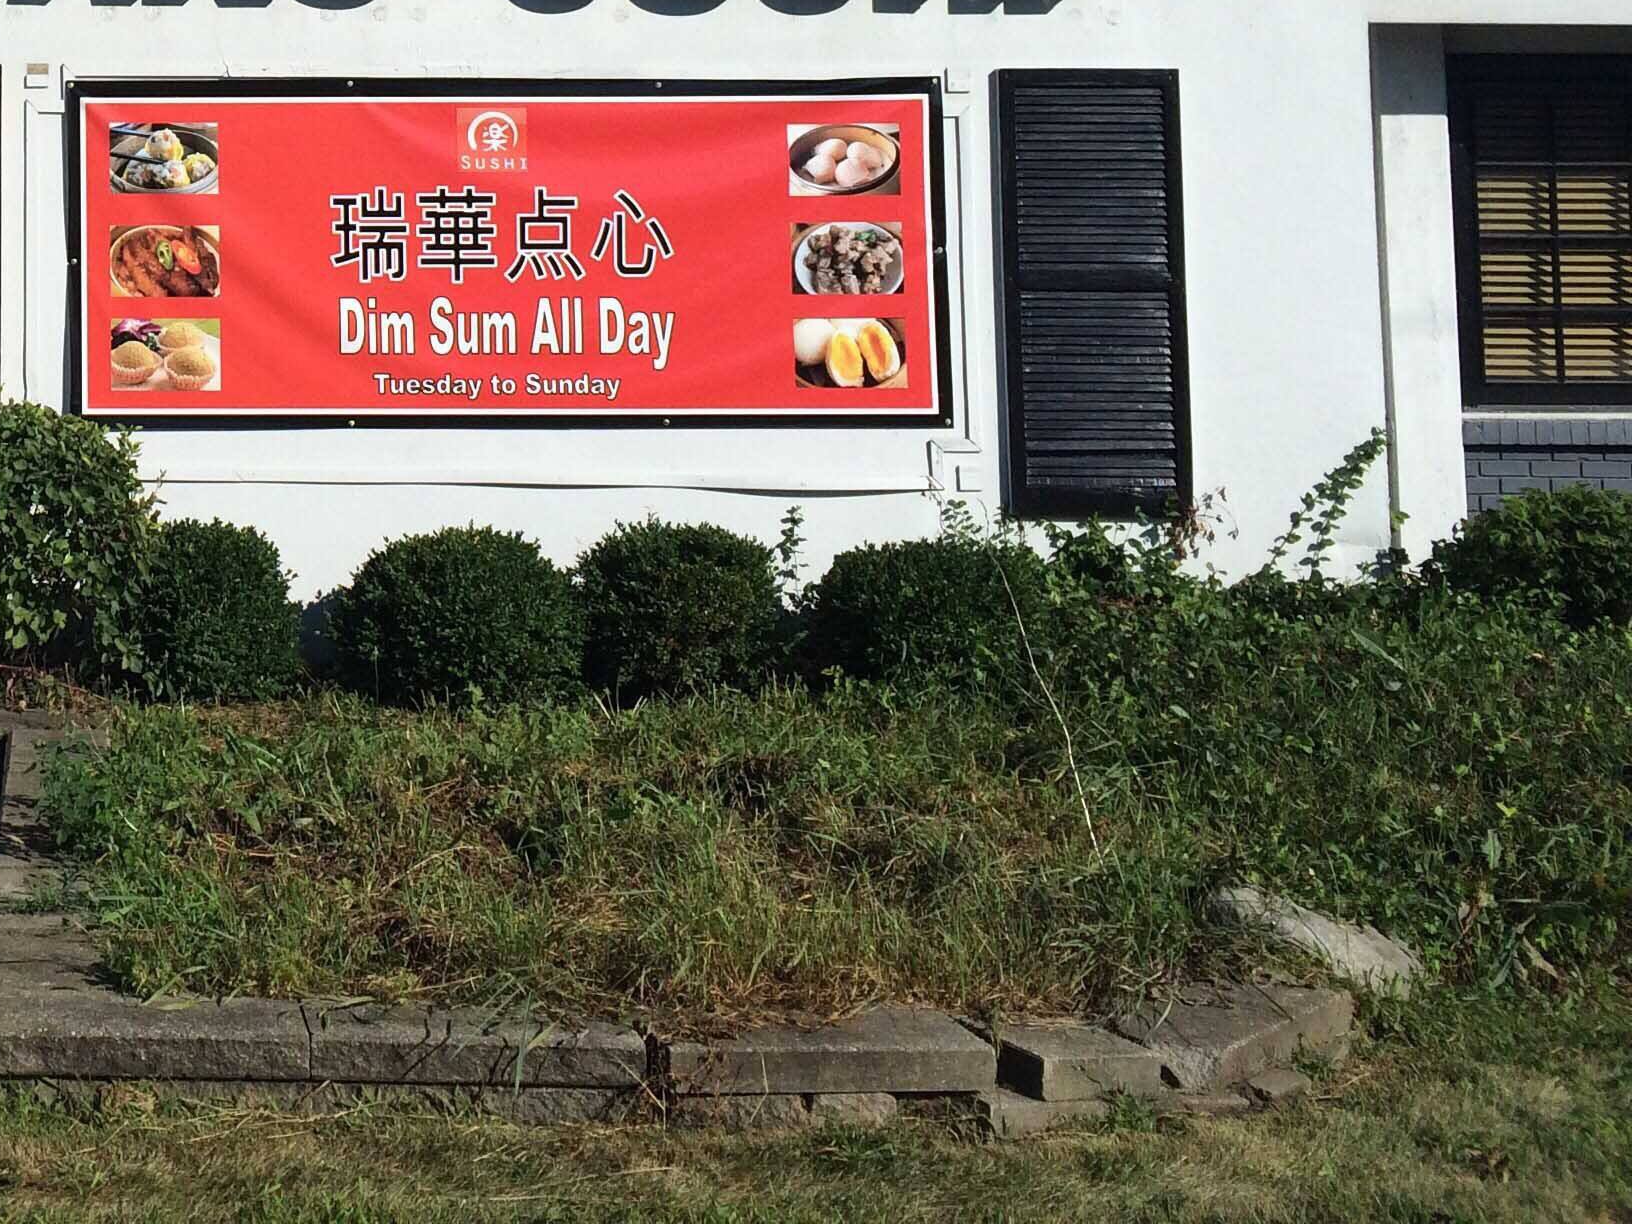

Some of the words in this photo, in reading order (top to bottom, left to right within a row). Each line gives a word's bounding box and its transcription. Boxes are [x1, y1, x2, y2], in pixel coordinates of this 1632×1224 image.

[330, 186, 673, 284] 瑞華点心
[338, 297, 415, 354] Dim
[429, 296, 517, 355] Sum
[530, 297, 584, 355] All
[598, 296, 675, 371] Day
[374, 373, 482, 400] Tuesday
[490, 374, 516, 394] to
[525, 373, 621, 400] Sunday
